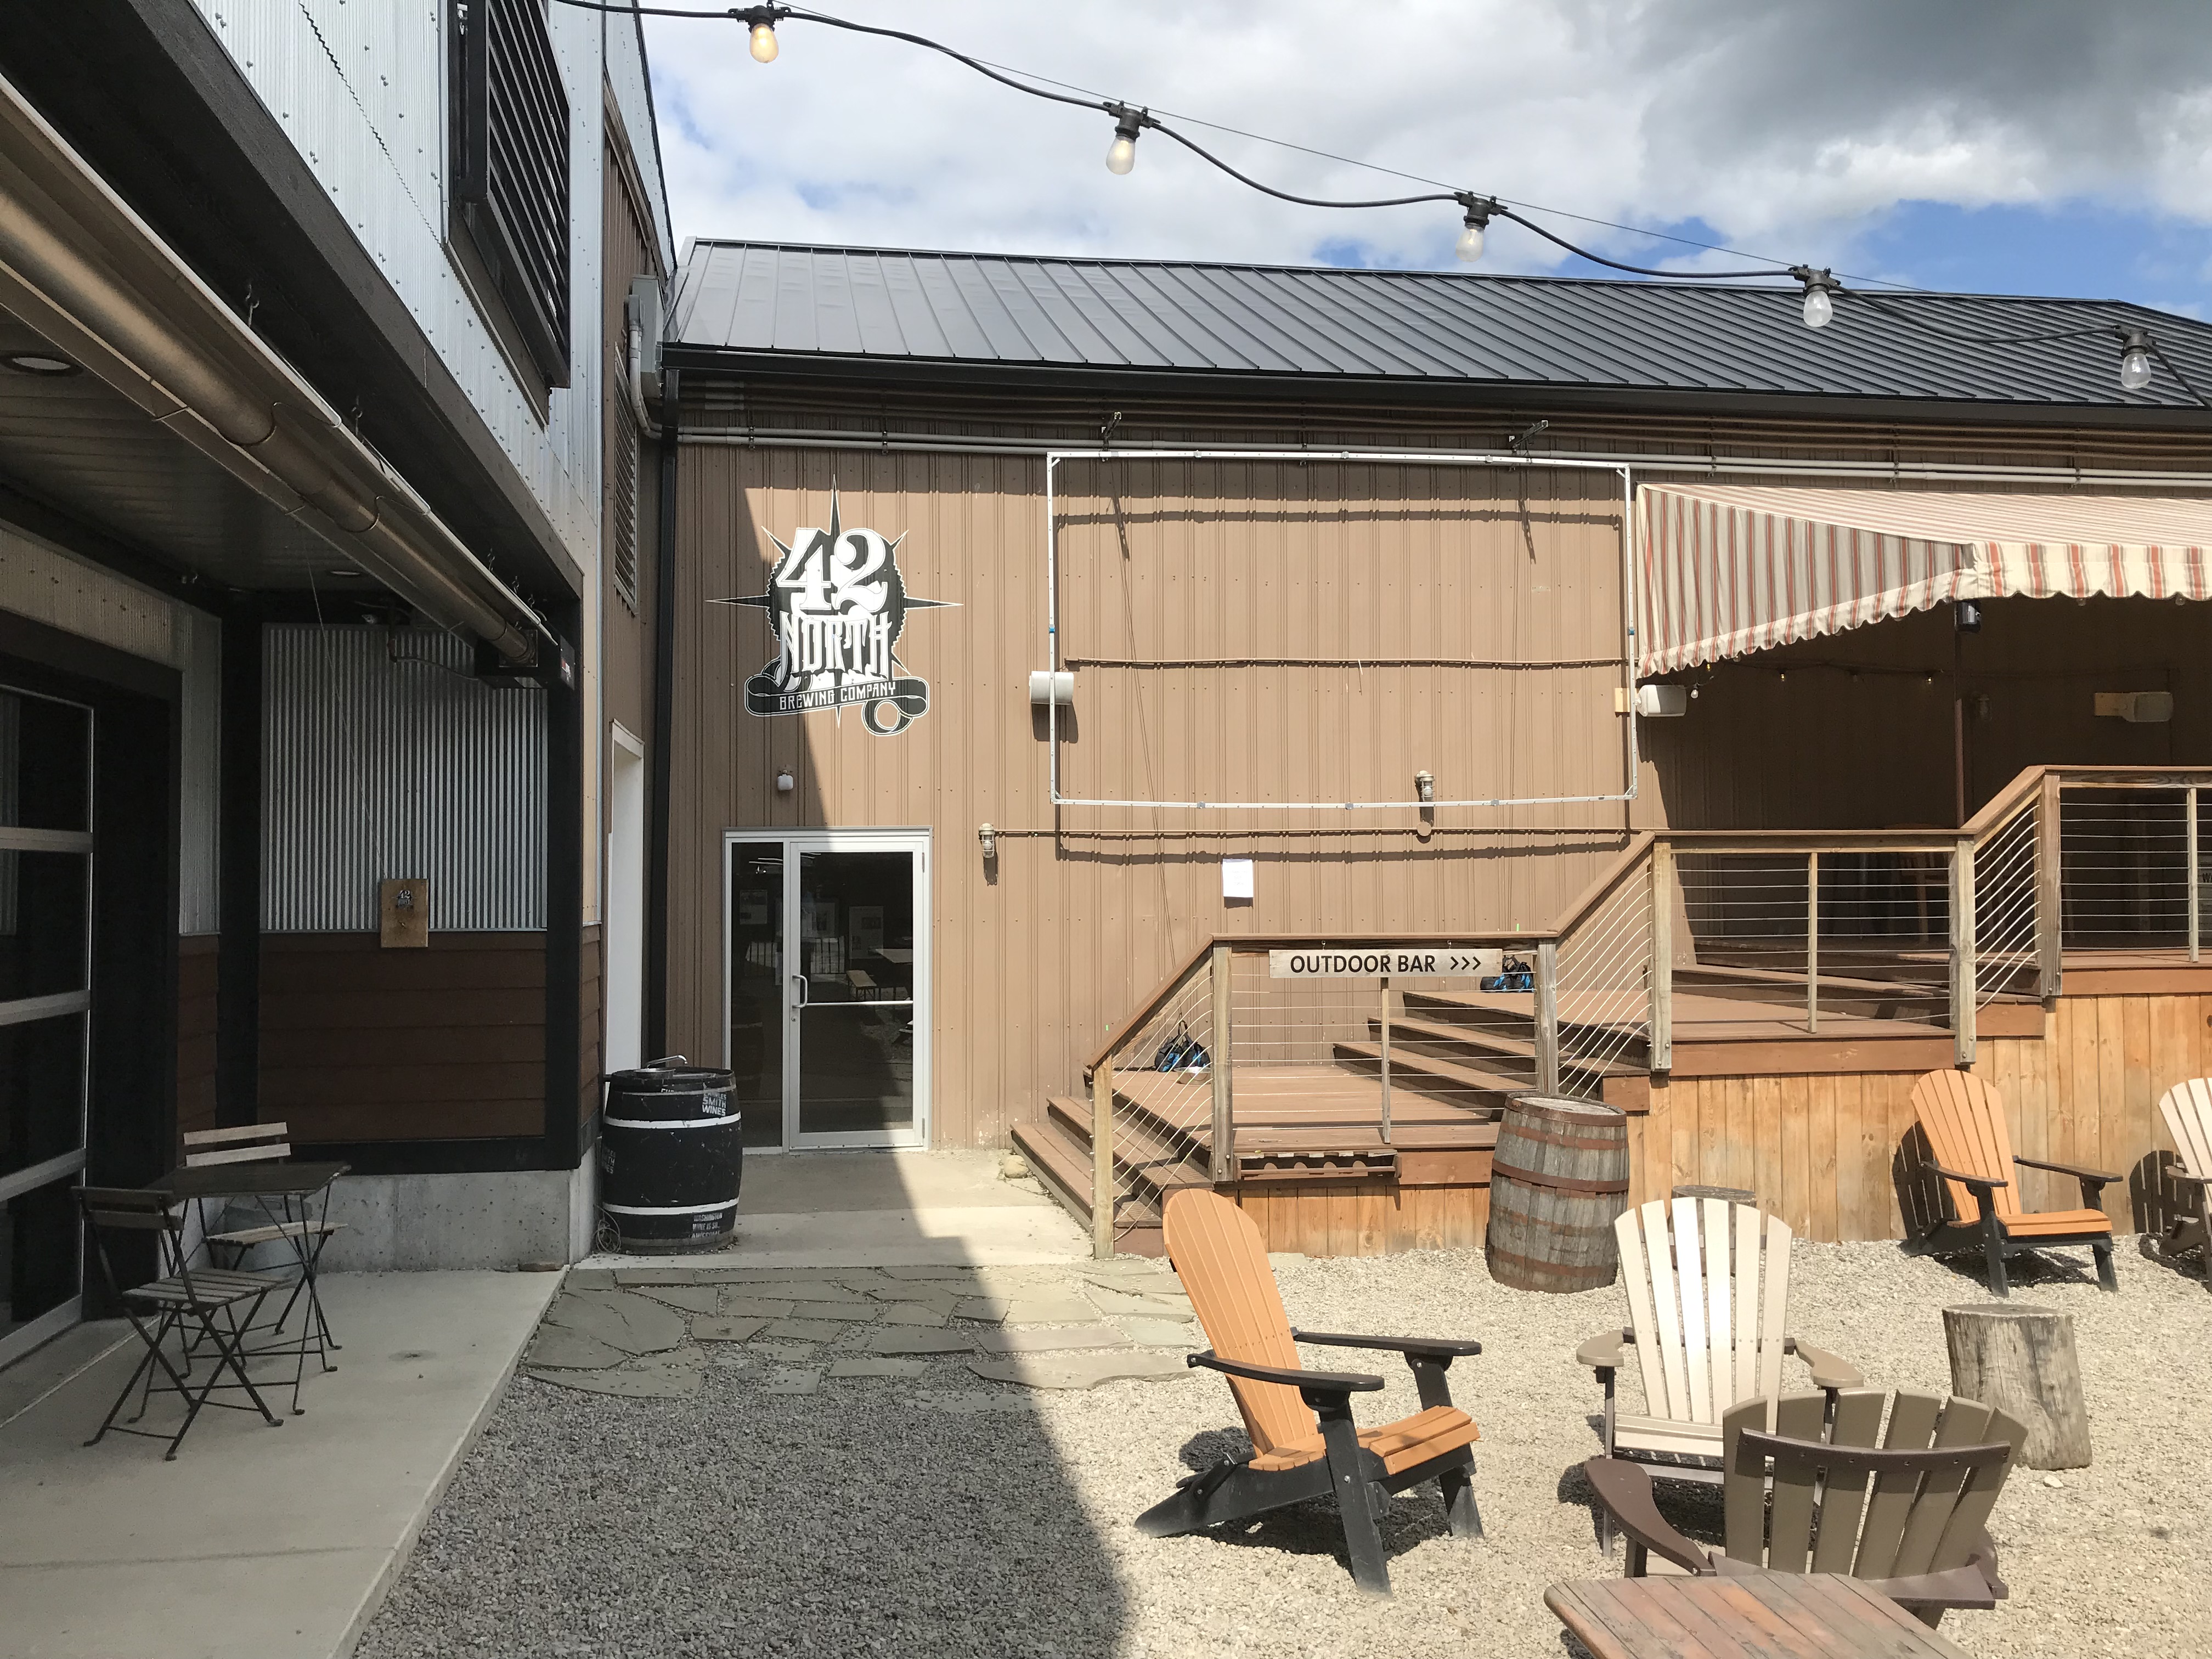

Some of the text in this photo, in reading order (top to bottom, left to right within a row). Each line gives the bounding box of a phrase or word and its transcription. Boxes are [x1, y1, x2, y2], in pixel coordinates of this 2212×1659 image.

[775, 528, 888, 612] 42
[778, 611, 893, 684] NORTH
[780, 681, 896, 710] BREWING COMPANY
[1290, 955, 1436, 973] OUTDOOR BAR
[702, 1096, 726, 1109] SMITH
[702, 1104, 726, 1116] WINES
